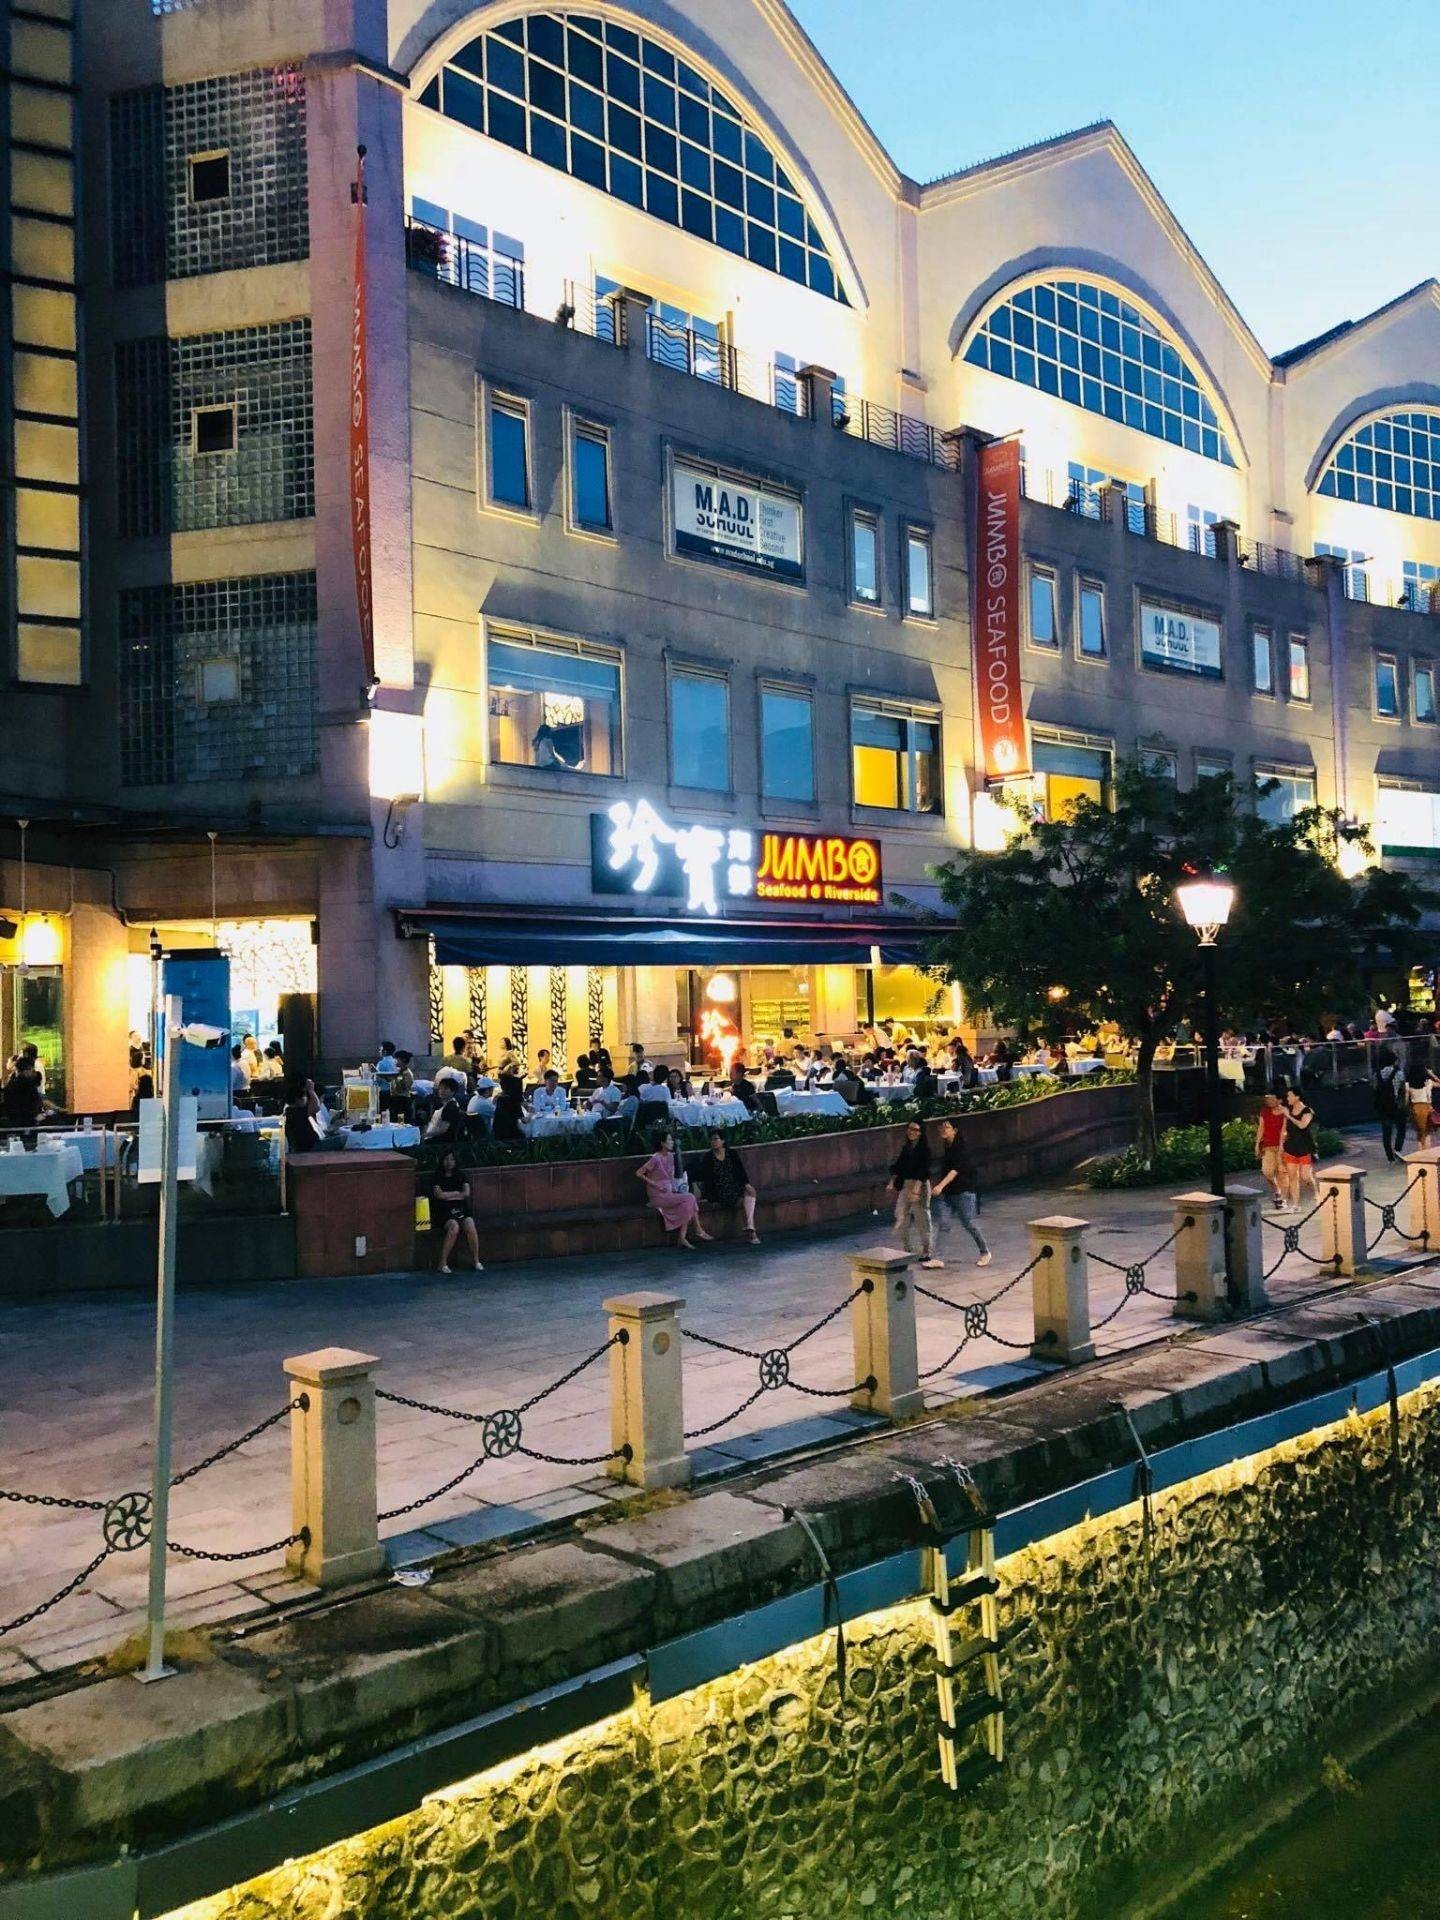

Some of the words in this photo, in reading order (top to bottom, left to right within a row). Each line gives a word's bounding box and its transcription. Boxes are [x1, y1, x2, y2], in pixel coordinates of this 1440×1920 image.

[695, 483, 754, 524] M.A.D.
[987, 492, 1007, 588] JUMBO
[1154, 615, 1189, 641] M.A.D.
[987, 596, 1010, 724] SEAFOOD
[757, 834, 877, 883] JUMBO
[757, 882, 807, 898] Seafood
[824, 885, 879, 902] Riverside
